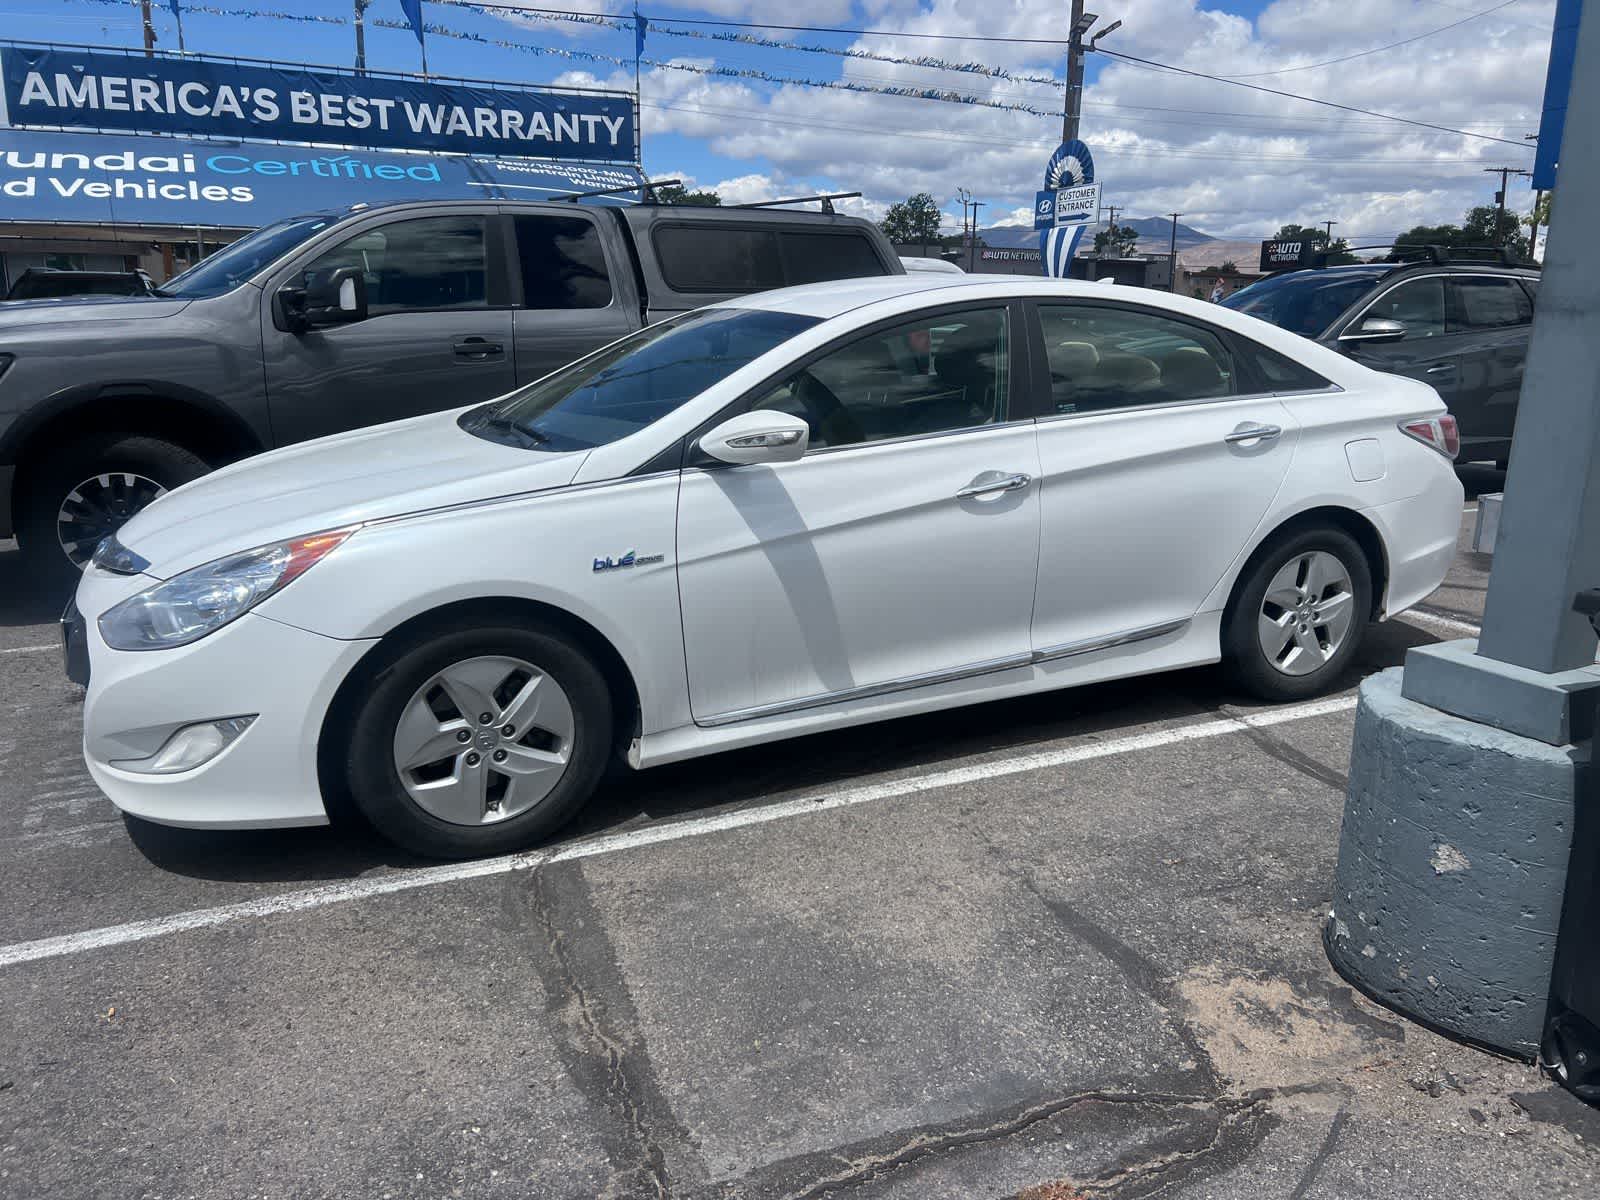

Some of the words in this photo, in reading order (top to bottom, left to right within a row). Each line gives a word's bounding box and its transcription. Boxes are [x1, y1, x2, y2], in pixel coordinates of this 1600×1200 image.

[19, 71, 281, 122] AMERICA'S
[291, 91, 396, 130] BEST
[403, 101, 625, 145] WARRANTY
[0, 151, 195, 173] undai
[206, 155, 441, 183] Certified
[497, 164, 581, 179] Powertrain
[583, 173, 638, 187] Limited
[0, 177, 36, 197] d
[48, 177, 255, 202] Vehicles
[569, 178, 639, 195] Warray
[1059, 188, 1096, 201] CUSTOMER
[1058, 200, 1094, 213] ENTRANCE
[985, 251, 1010, 260] AUTO
[1010, 252, 1042, 261] NETWOR
[1272, 242, 1302, 253] AUTO
[1270, 253, 1299, 261] NETWORK
[592, 551, 635, 572] blue
